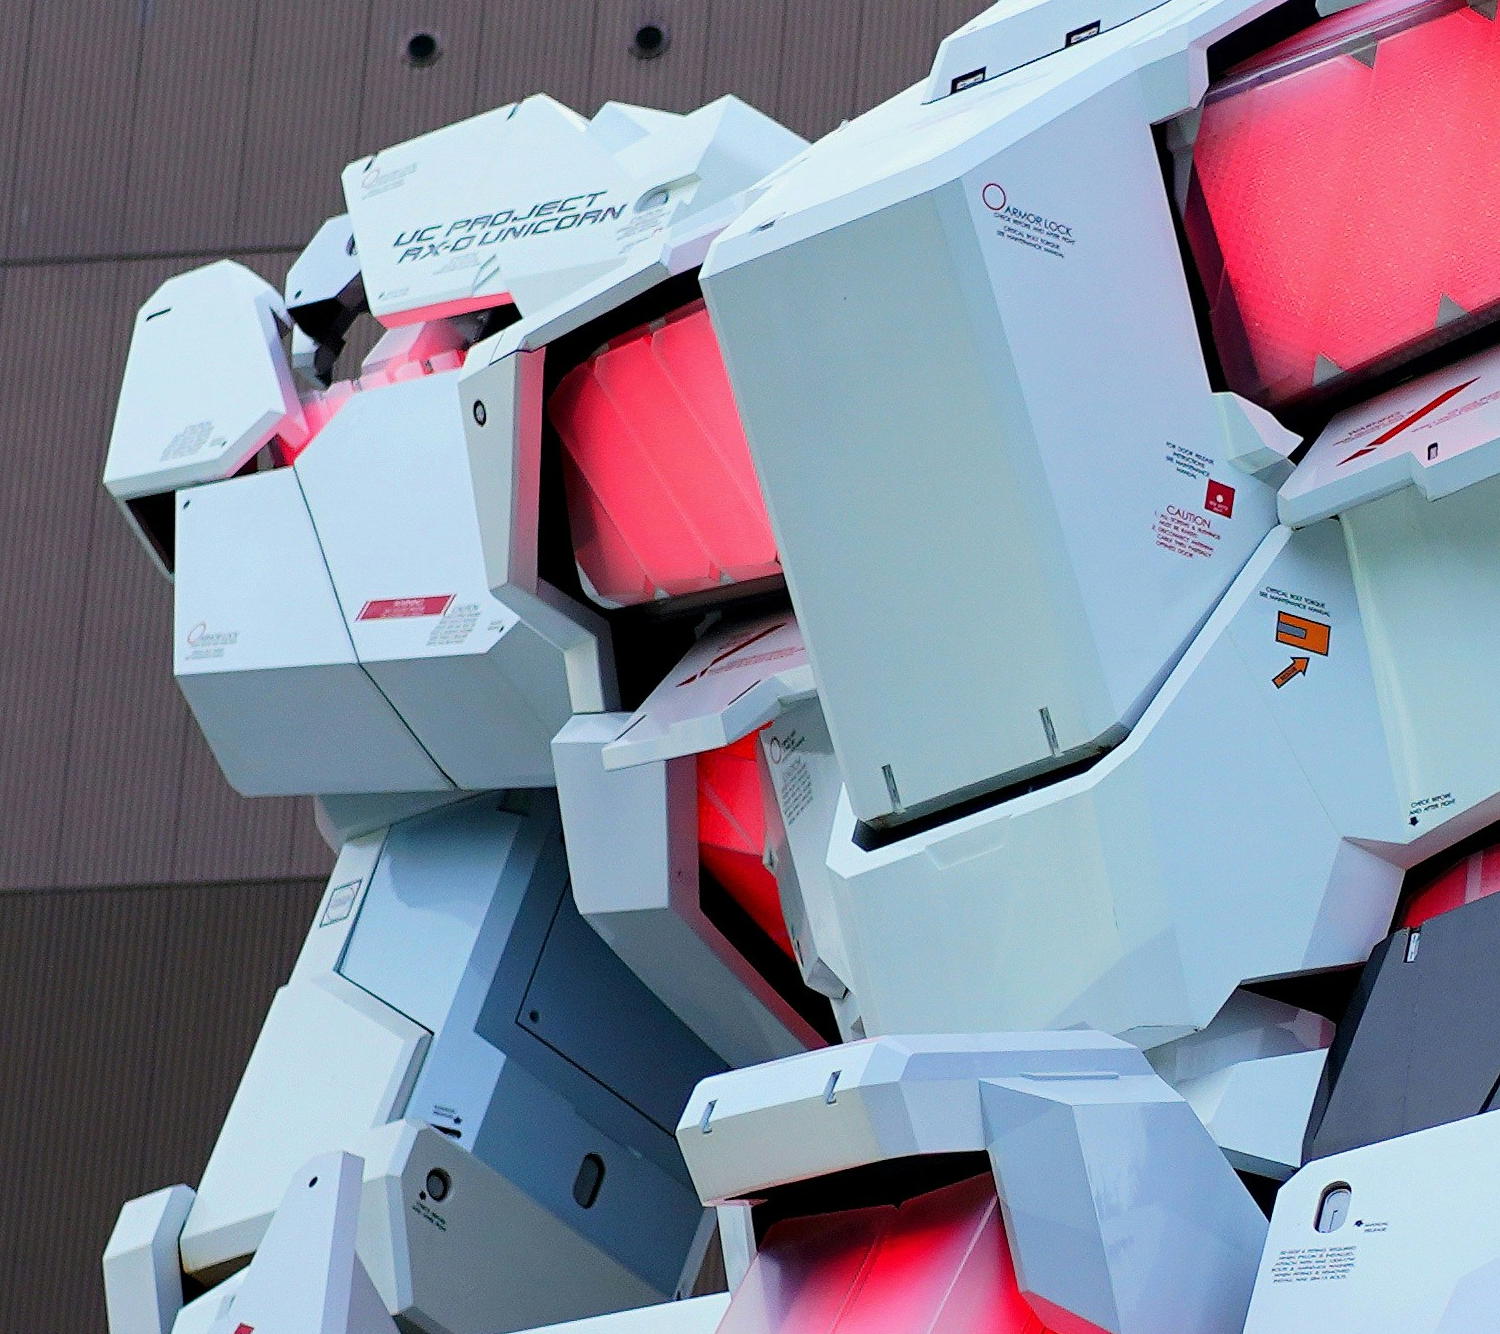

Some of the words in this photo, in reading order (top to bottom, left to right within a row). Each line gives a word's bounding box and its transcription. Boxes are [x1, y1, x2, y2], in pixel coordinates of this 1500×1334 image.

[392, 225, 442, 248] UC
[445, 191, 608, 237] PROJECT
[477, 203, 629, 248] UNICORN
[1004, 206, 1043, 224] ARMOR
[1043, 218, 1074, 238] LOCK
[1166, 505, 1211, 529] CAUTION
